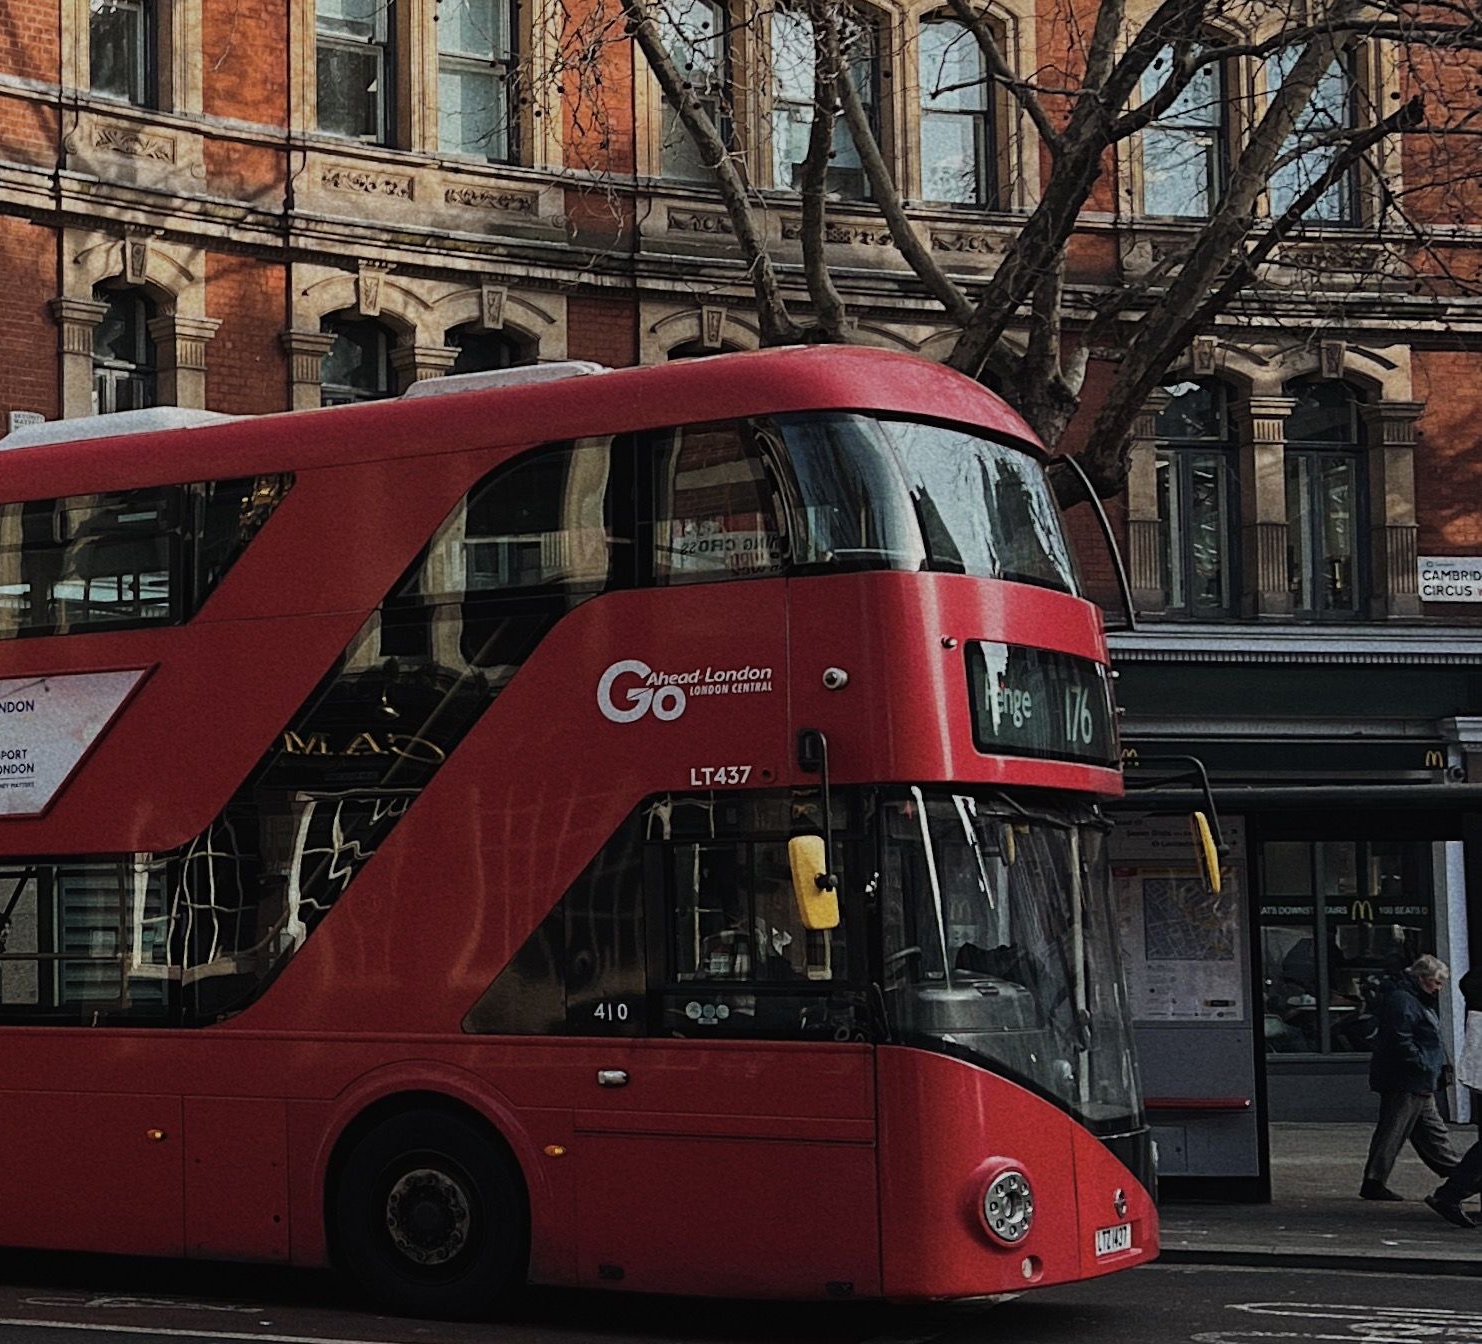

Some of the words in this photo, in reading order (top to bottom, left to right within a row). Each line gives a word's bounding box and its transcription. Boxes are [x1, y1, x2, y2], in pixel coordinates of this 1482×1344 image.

[1422, 569, 1482, 581] CAMBRID
[1423, 584, 1473, 597] CIRCUS
[596, 659, 687, 724] Go
[689, 683, 729, 697] LONDON
[731, 681, 773, 694] CENTRAL
[1065, 686, 1093, 744] 176
[690, 765, 753, 786] LT437
